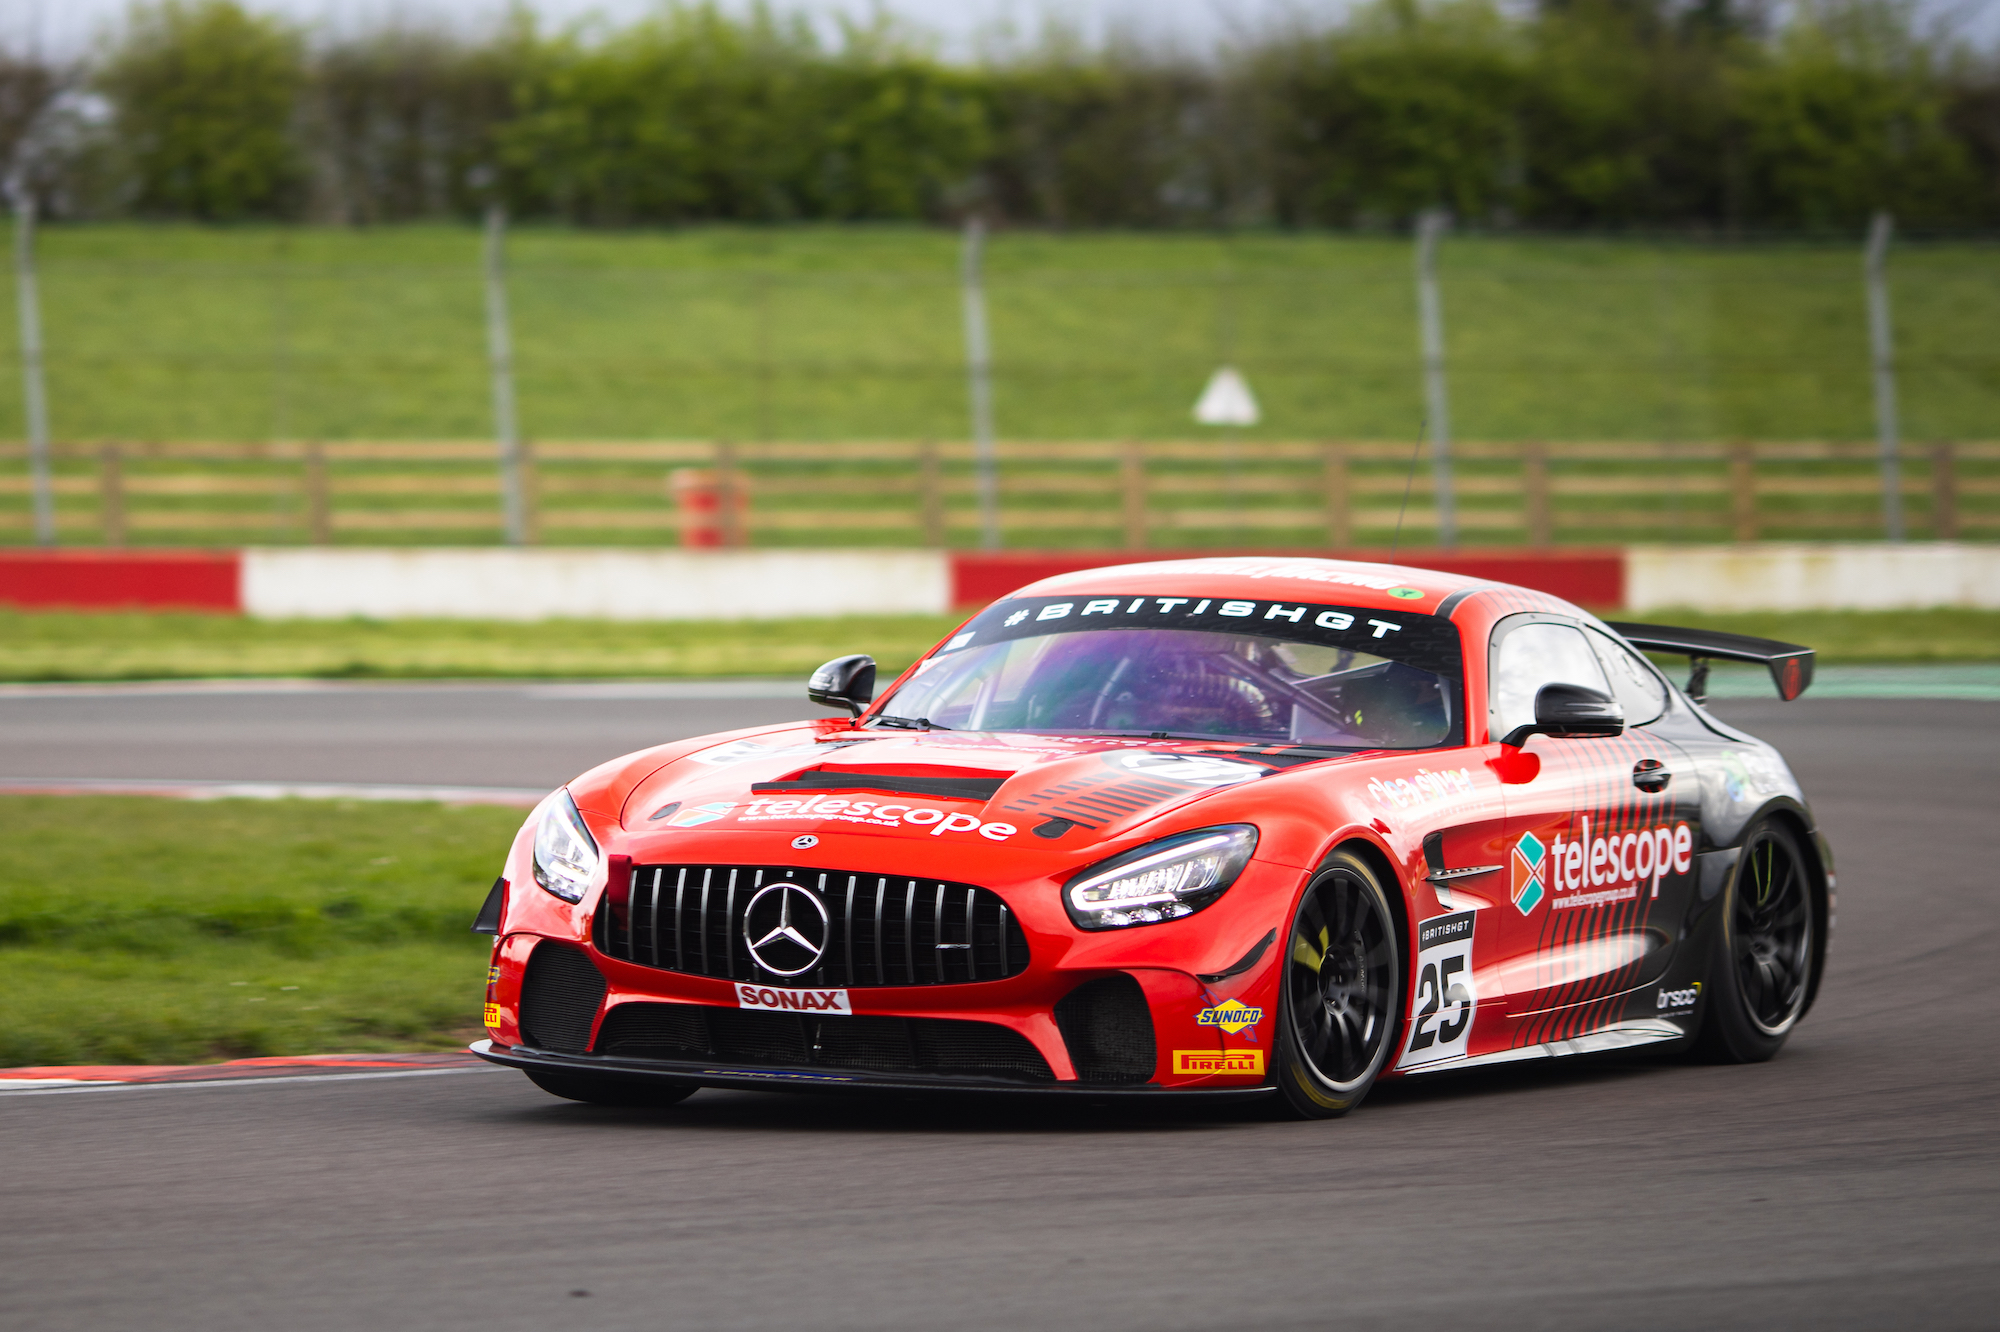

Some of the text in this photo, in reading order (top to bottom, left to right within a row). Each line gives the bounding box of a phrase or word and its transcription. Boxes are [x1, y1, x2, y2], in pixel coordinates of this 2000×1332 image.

[1004, 599, 1401, 638] #BRITISHGT
[745, 795, 1017, 840] telescope
[1551, 816, 1692, 898] telescope
[1422, 920, 1469, 941] #BRITISHGT
[741, 986, 844, 1009] SONAX
[1408, 954, 1470, 1053] 25
[1201, 1011, 1258, 1023] SUNOCO
[1182, 1055, 1254, 1070] PIRELLI
